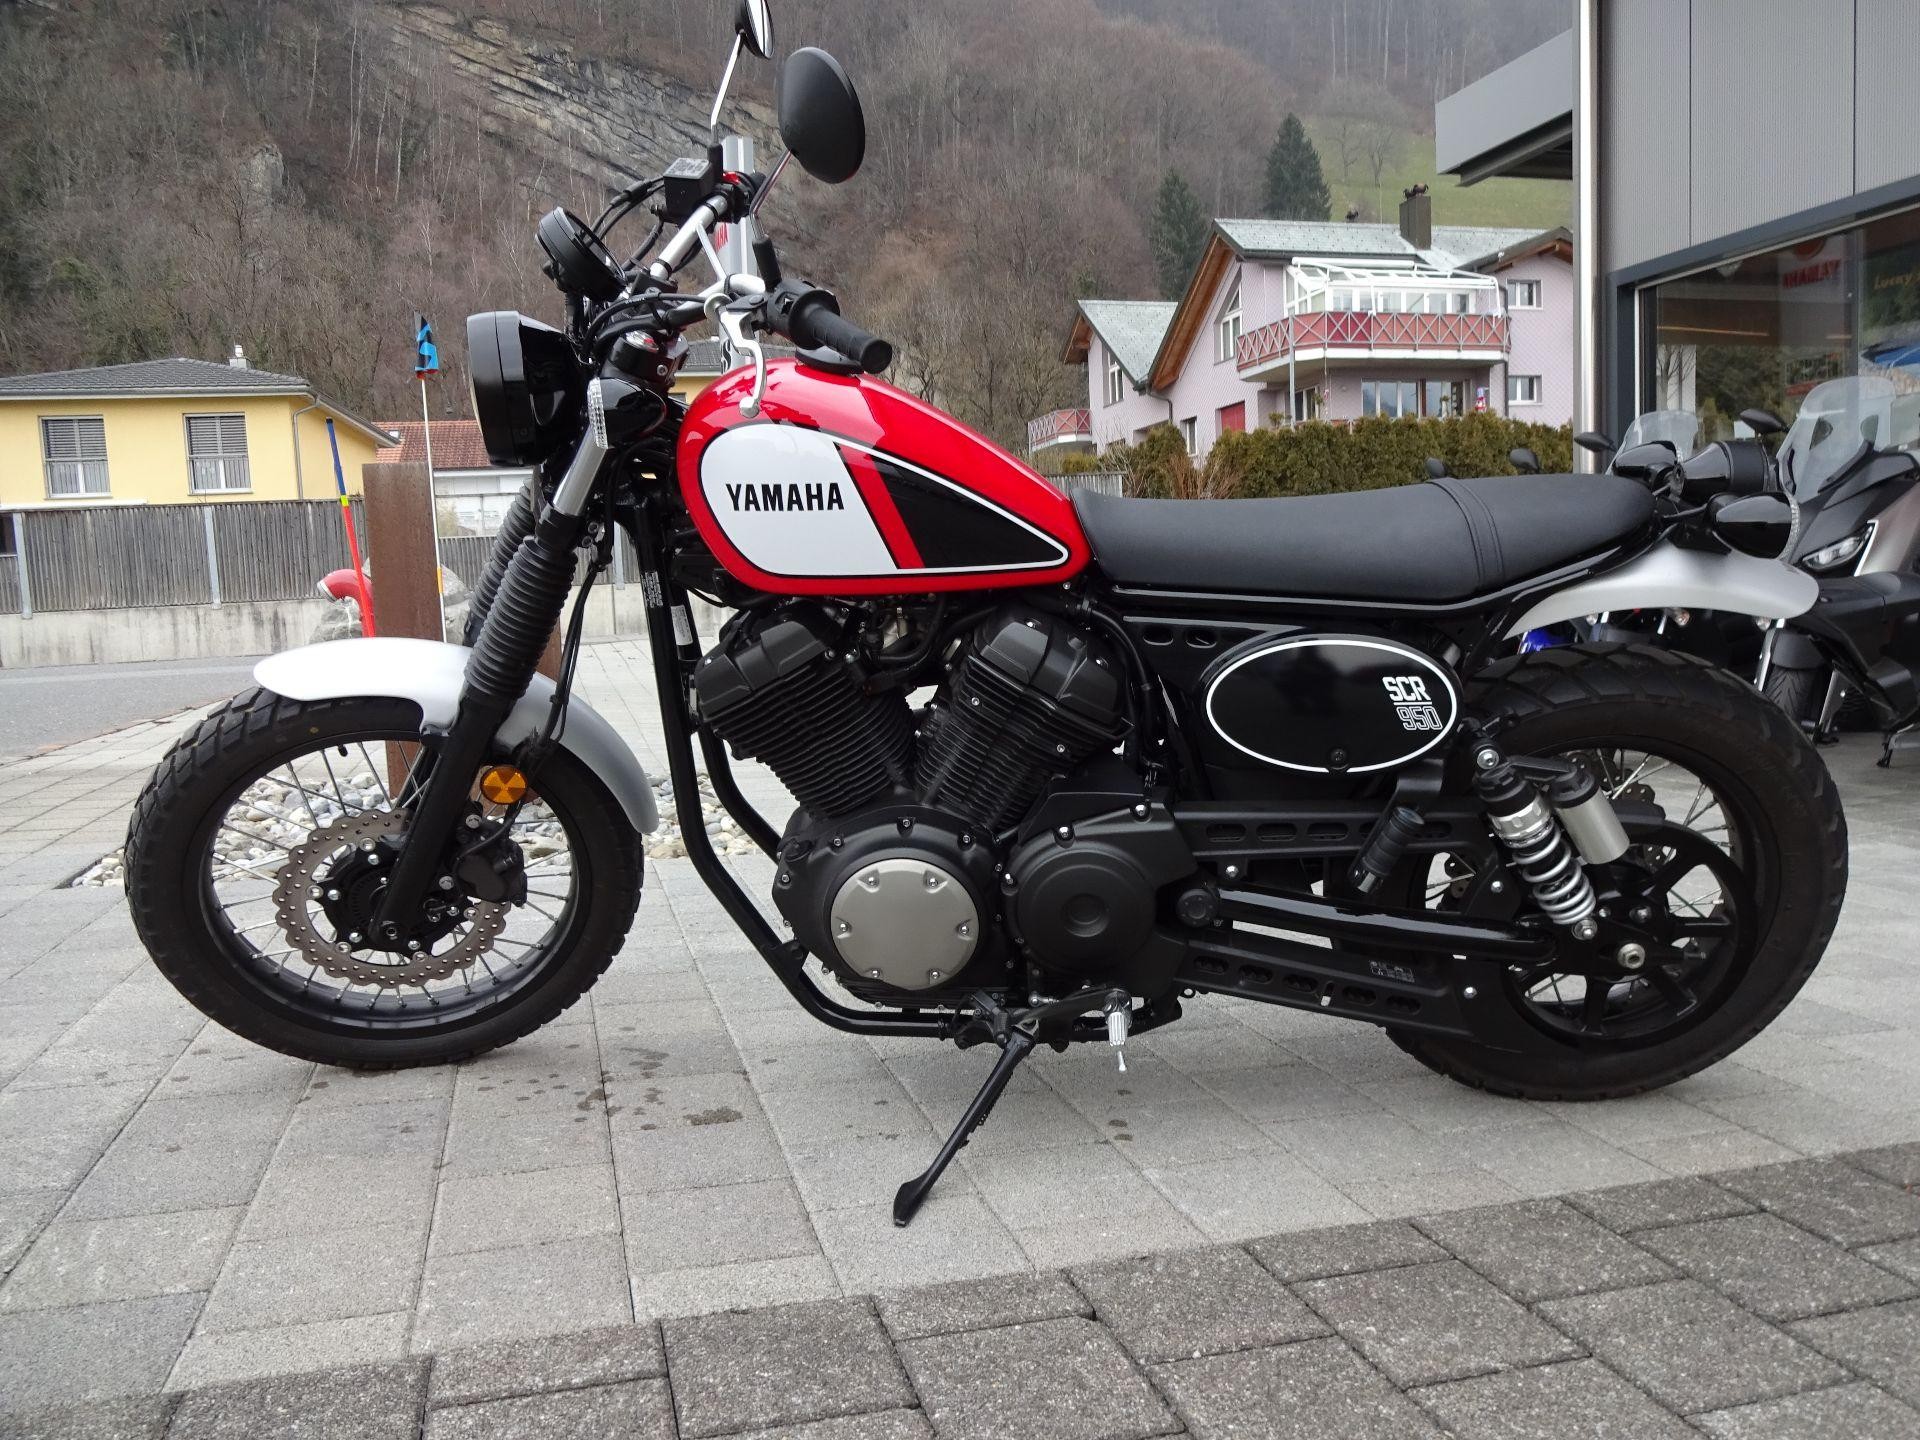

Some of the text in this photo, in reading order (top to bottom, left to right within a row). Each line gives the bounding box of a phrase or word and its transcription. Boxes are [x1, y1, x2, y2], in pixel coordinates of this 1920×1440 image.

[725, 482, 845, 512] YAMAHA
[1382, 676, 1432, 701] SCR
[1396, 706, 1443, 730] 950
